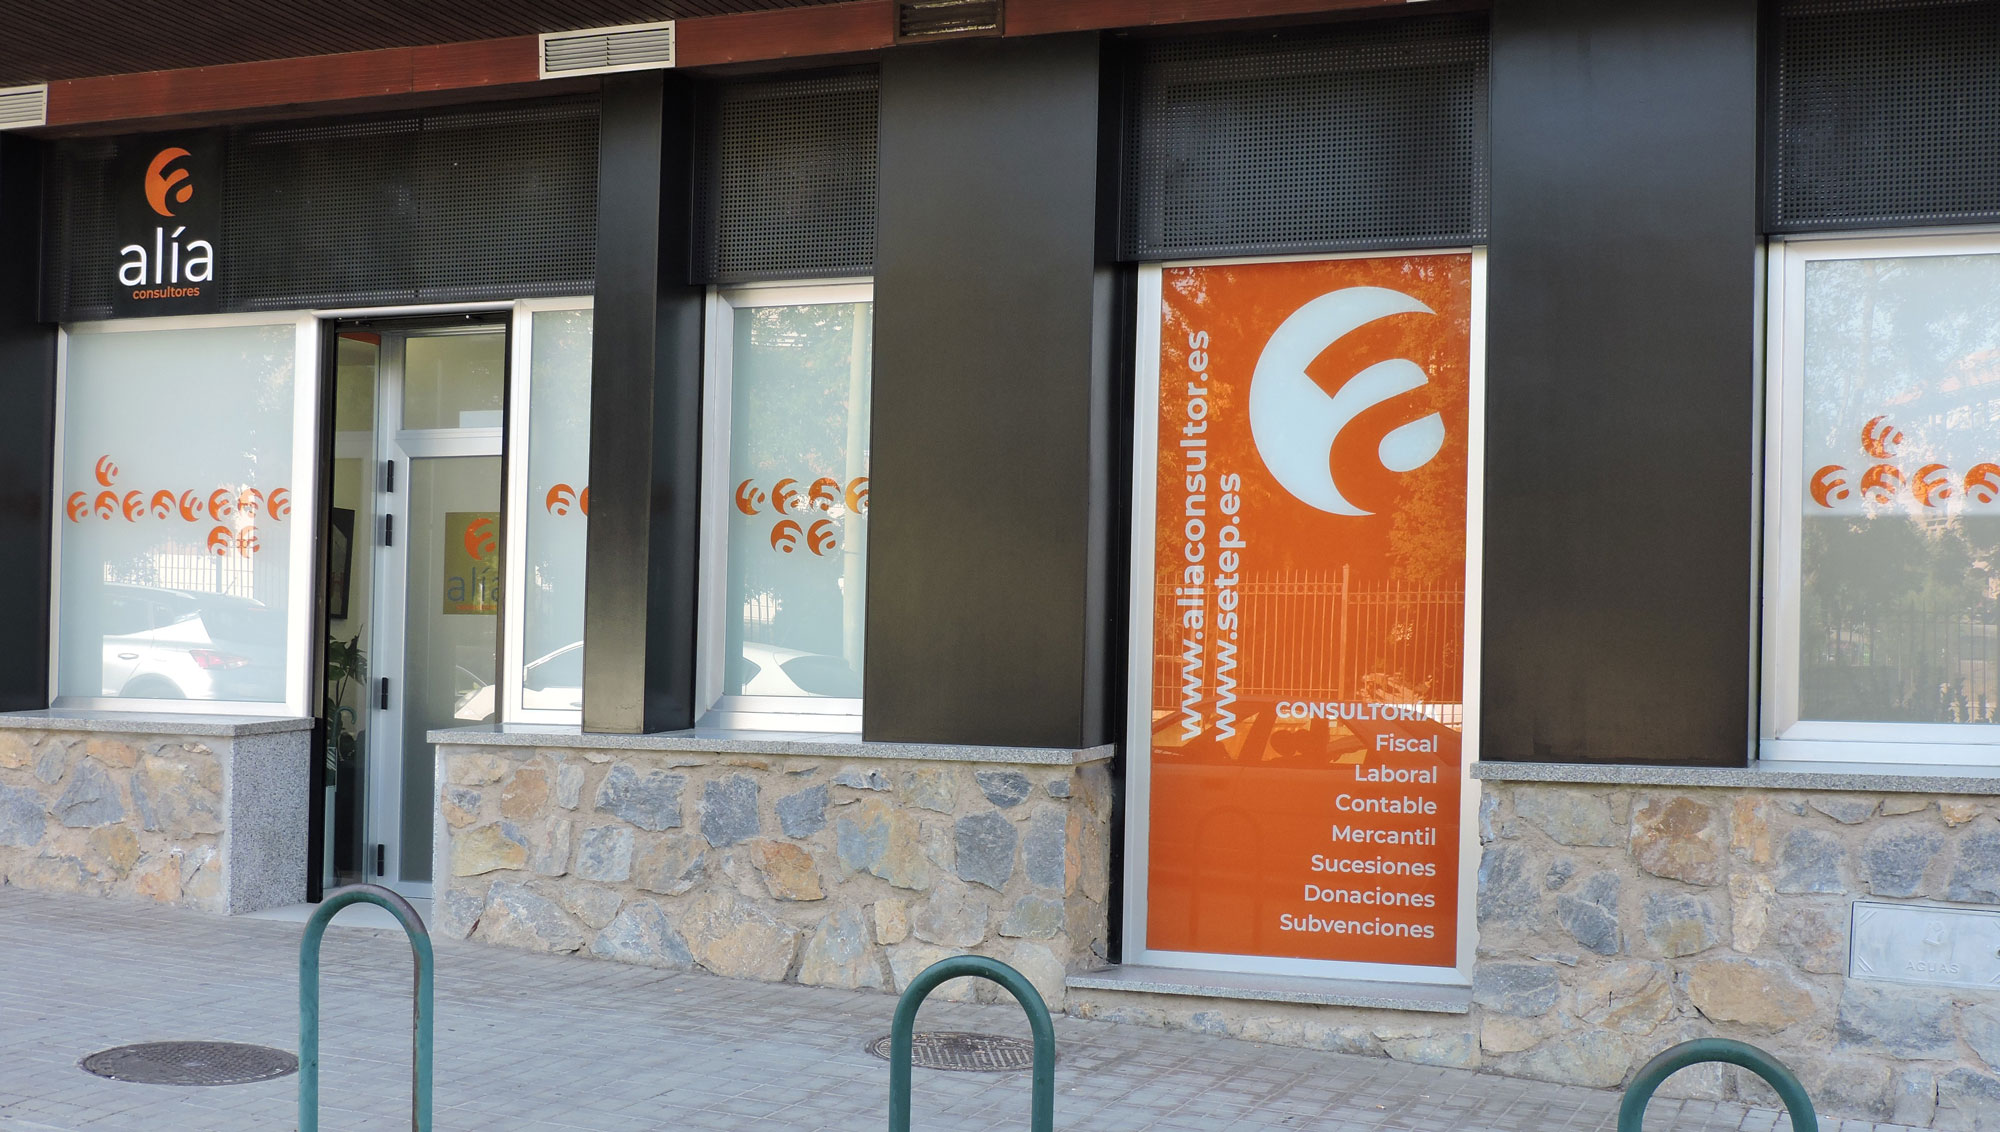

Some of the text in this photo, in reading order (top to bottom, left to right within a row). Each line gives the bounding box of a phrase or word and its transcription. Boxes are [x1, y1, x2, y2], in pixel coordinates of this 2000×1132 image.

[118, 226, 214, 286] alía
[132, 286, 200, 300] consultores
[1175, 330, 1209, 742] www.aliaconsultor.es
[1214, 473, 1247, 742] www.setep.es
[1376, 733, 1438, 753] Fiscal
[1355, 764, 1438, 784] Laboral
[1335, 793, 1438, 815] Contable
[1332, 824, 1437, 846] Mercantil
[1311, 854, 1437, 877] Sucesiones
[1304, 884, 1436, 908] Donaciones
[1279, 913, 1435, 939] Subvenciones
[1905, 959, 1960, 975] AGUAS
